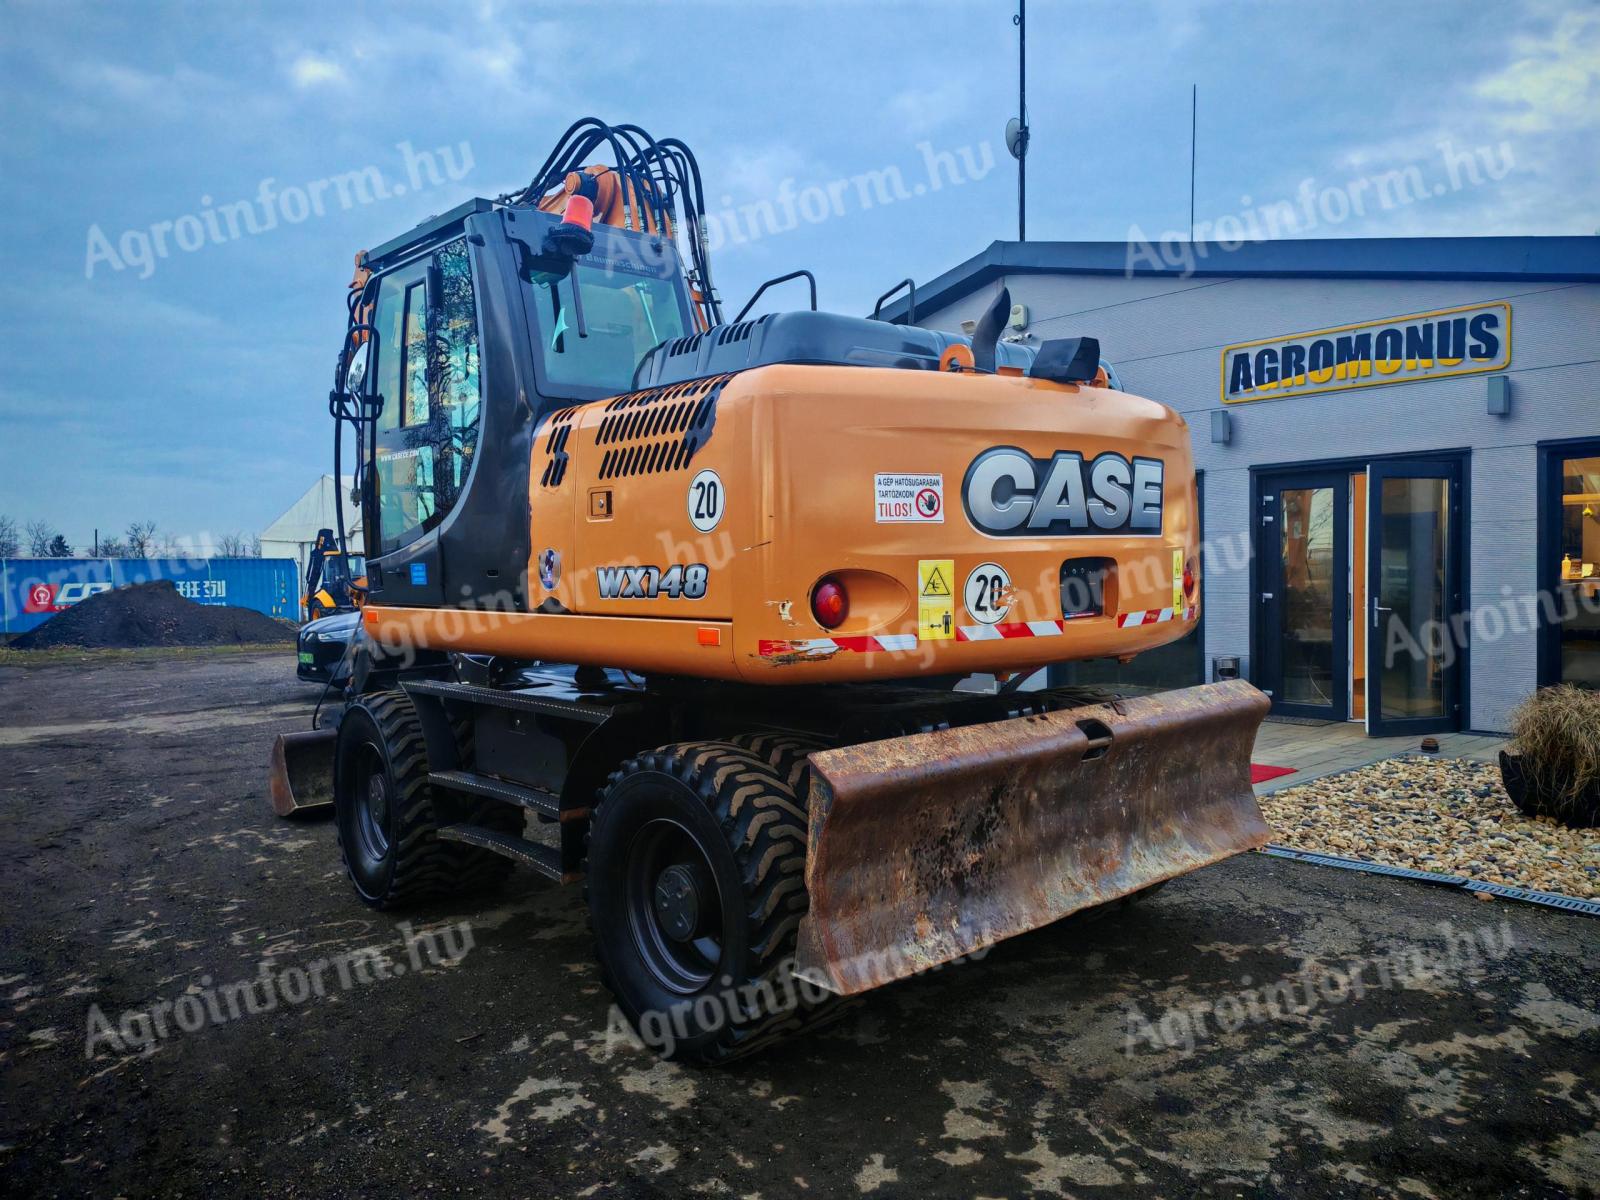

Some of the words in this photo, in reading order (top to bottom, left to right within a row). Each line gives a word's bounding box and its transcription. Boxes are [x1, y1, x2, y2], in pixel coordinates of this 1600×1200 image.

[1229, 313, 1499, 395] AGROMONUS
[694, 480, 717, 519] 20
[882, 477, 894, 486] GÉP
[966, 446, 1163, 532] CASE
[878, 502, 912, 517] TILOS!
[596, 563, 709, 599] WX148
[974, 574, 1002, 612] 20
